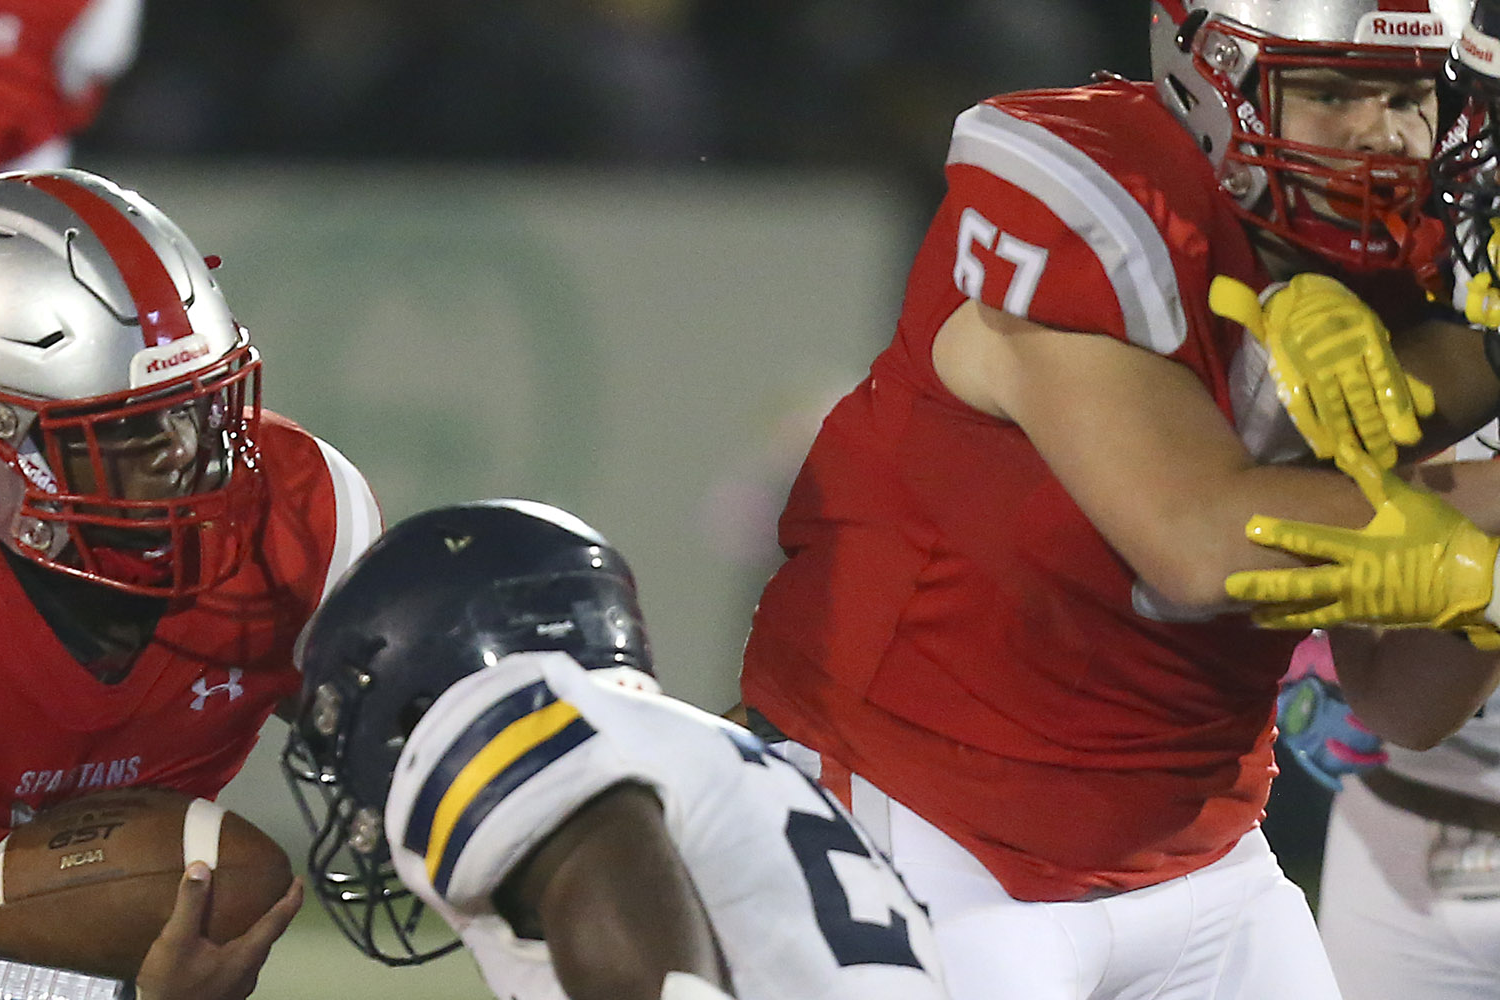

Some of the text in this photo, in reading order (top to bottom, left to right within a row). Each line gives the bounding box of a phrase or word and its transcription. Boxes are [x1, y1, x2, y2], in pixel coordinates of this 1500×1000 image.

[1373, 18, 1443, 36] Riddell
[953, 206, 1049, 319] 67
[60, 848, 104, 870] NCAA
